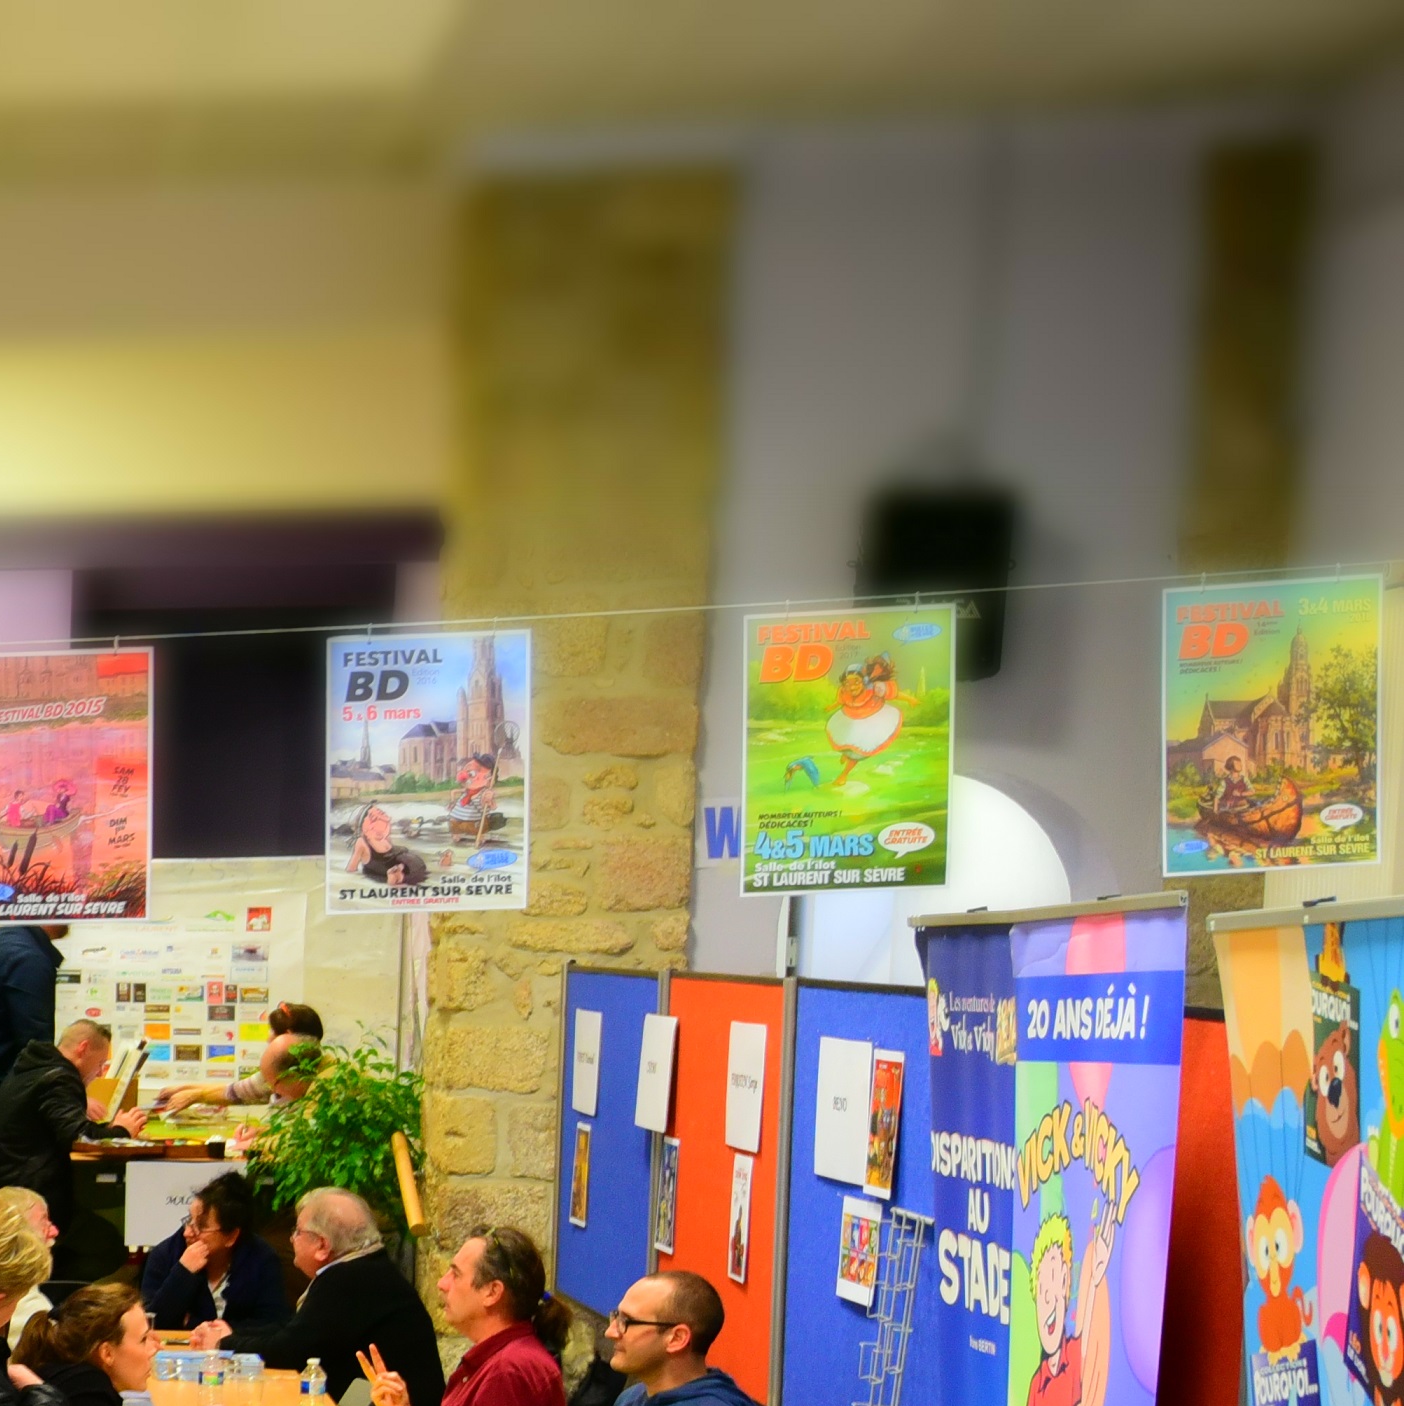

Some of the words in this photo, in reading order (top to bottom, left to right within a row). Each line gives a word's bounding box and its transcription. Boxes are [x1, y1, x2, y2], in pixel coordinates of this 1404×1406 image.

[1176, 600, 1284, 623] FESTIVAL
[1298, 598, 1329, 617] 3&4
[1332, 598, 1371, 613] MARS
[757, 620, 870, 644] FESTIVAL
[1178, 622, 1249, 660] BD
[343, 648, 442, 668] FESTIVAL
[759, 643, 833, 683] BD
[345, 670, 410, 703] BD
[43, 702, 66, 721] BD
[65, 697, 107, 718] 2015
[343, 706, 353, 721] 5
[366, 705, 378, 721] 6
[383, 706, 421, 720] mars
[113, 765, 135, 776] SAM
[109, 816, 128, 828] DIM
[758, 811, 803, 820] NOMBREUX
[802, 811, 838, 819] AUTEURS
[759, 818, 808, 830] DÉDICACES
[108, 833, 136, 846] MARS
[884, 835, 928, 846] GRATUITE
[889, 828, 924, 838] ENTRÉE
[810, 834, 874, 858] MARS
[1255, 849, 1268, 860] ST
[1269, 845, 1316, 859] LAURENT
[1316, 844, 1338, 857] SUR
[753, 873, 770, 888] ST
[771, 870, 832, 887] LAURENT
[833, 869, 860, 884] SUR
[339, 889, 356, 900] ST
[360, 886, 428, 899] LAURENT
[431, 885, 462, 897] SUR
[465, 884, 513, 896] SEVRE
[423, 896, 460, 905] GRATUITE
[56, 902, 82, 916] SUR
[1026, 1001, 1049, 1041] 20
[1052, 997, 1093, 1042] ANS
[1094, 982, 1138, 1041] DÉJÀ
[1139, 994, 1150, 1040] !
[1017, 1100, 1071, 1210] VICK
[1072, 1116, 1085, 1155] &
[1082, 1096, 1142, 1225] VICKY
[967, 1187, 990, 1234] AU
[938, 1232, 1011, 1326] STADE
